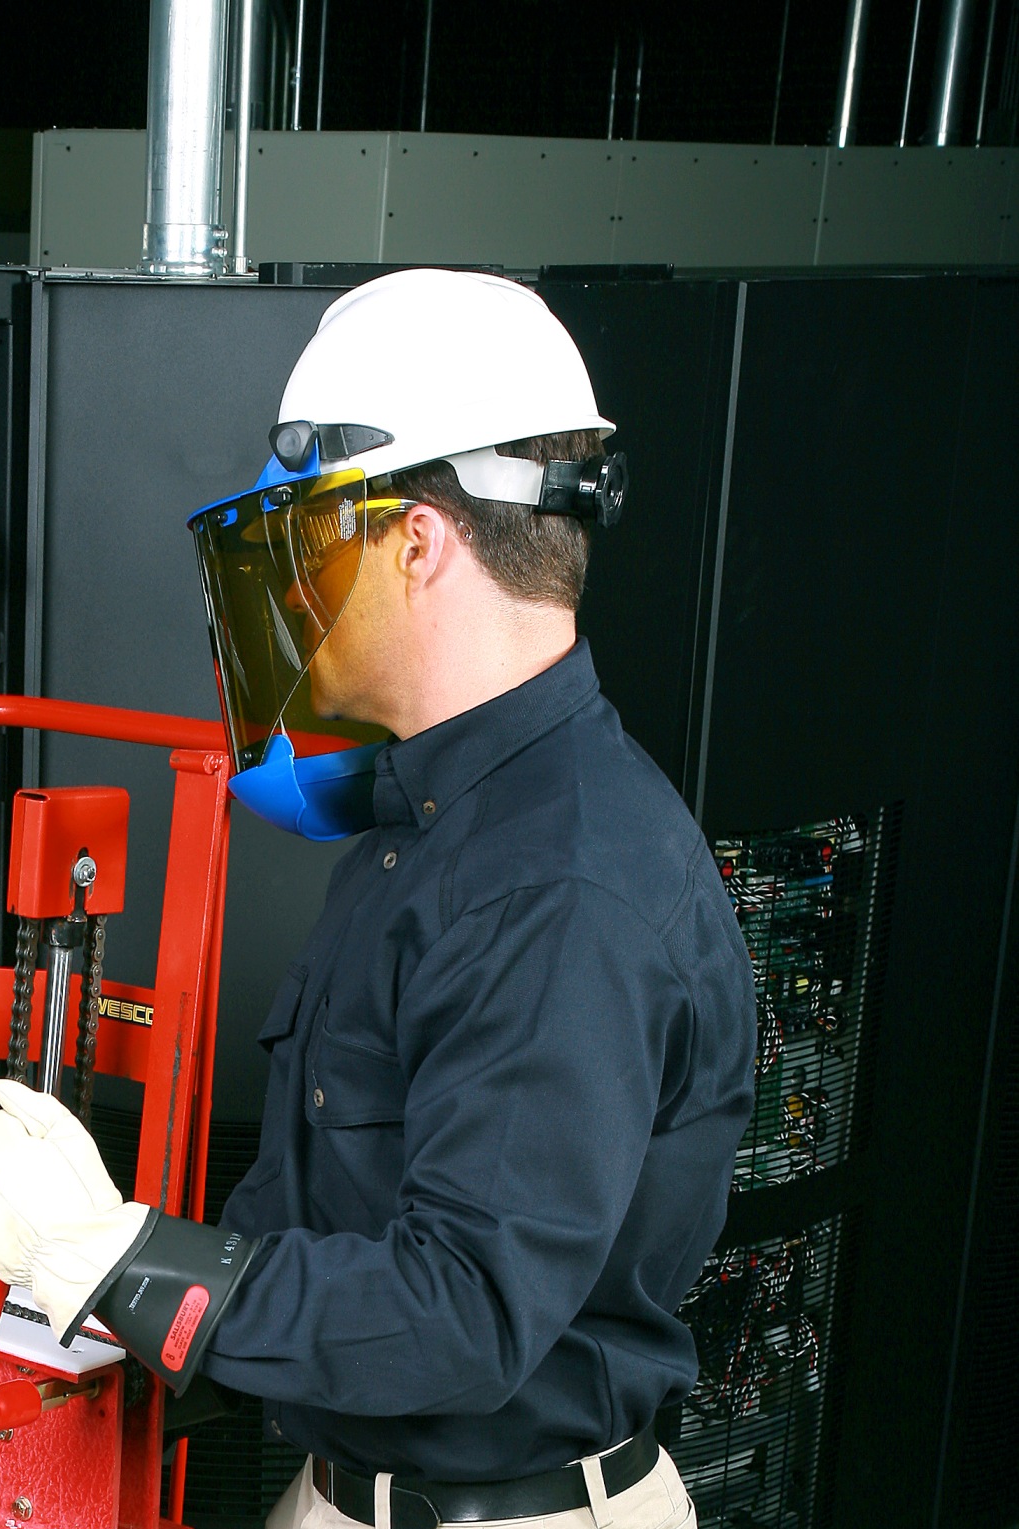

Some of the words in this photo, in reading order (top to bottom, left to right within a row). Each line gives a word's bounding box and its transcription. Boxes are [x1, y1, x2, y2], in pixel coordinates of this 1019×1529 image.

[221, 1257, 232, 1265] K
[170, 1301, 190, 1341] SALISBURY
[165, 1352, 176, 1361] 8
